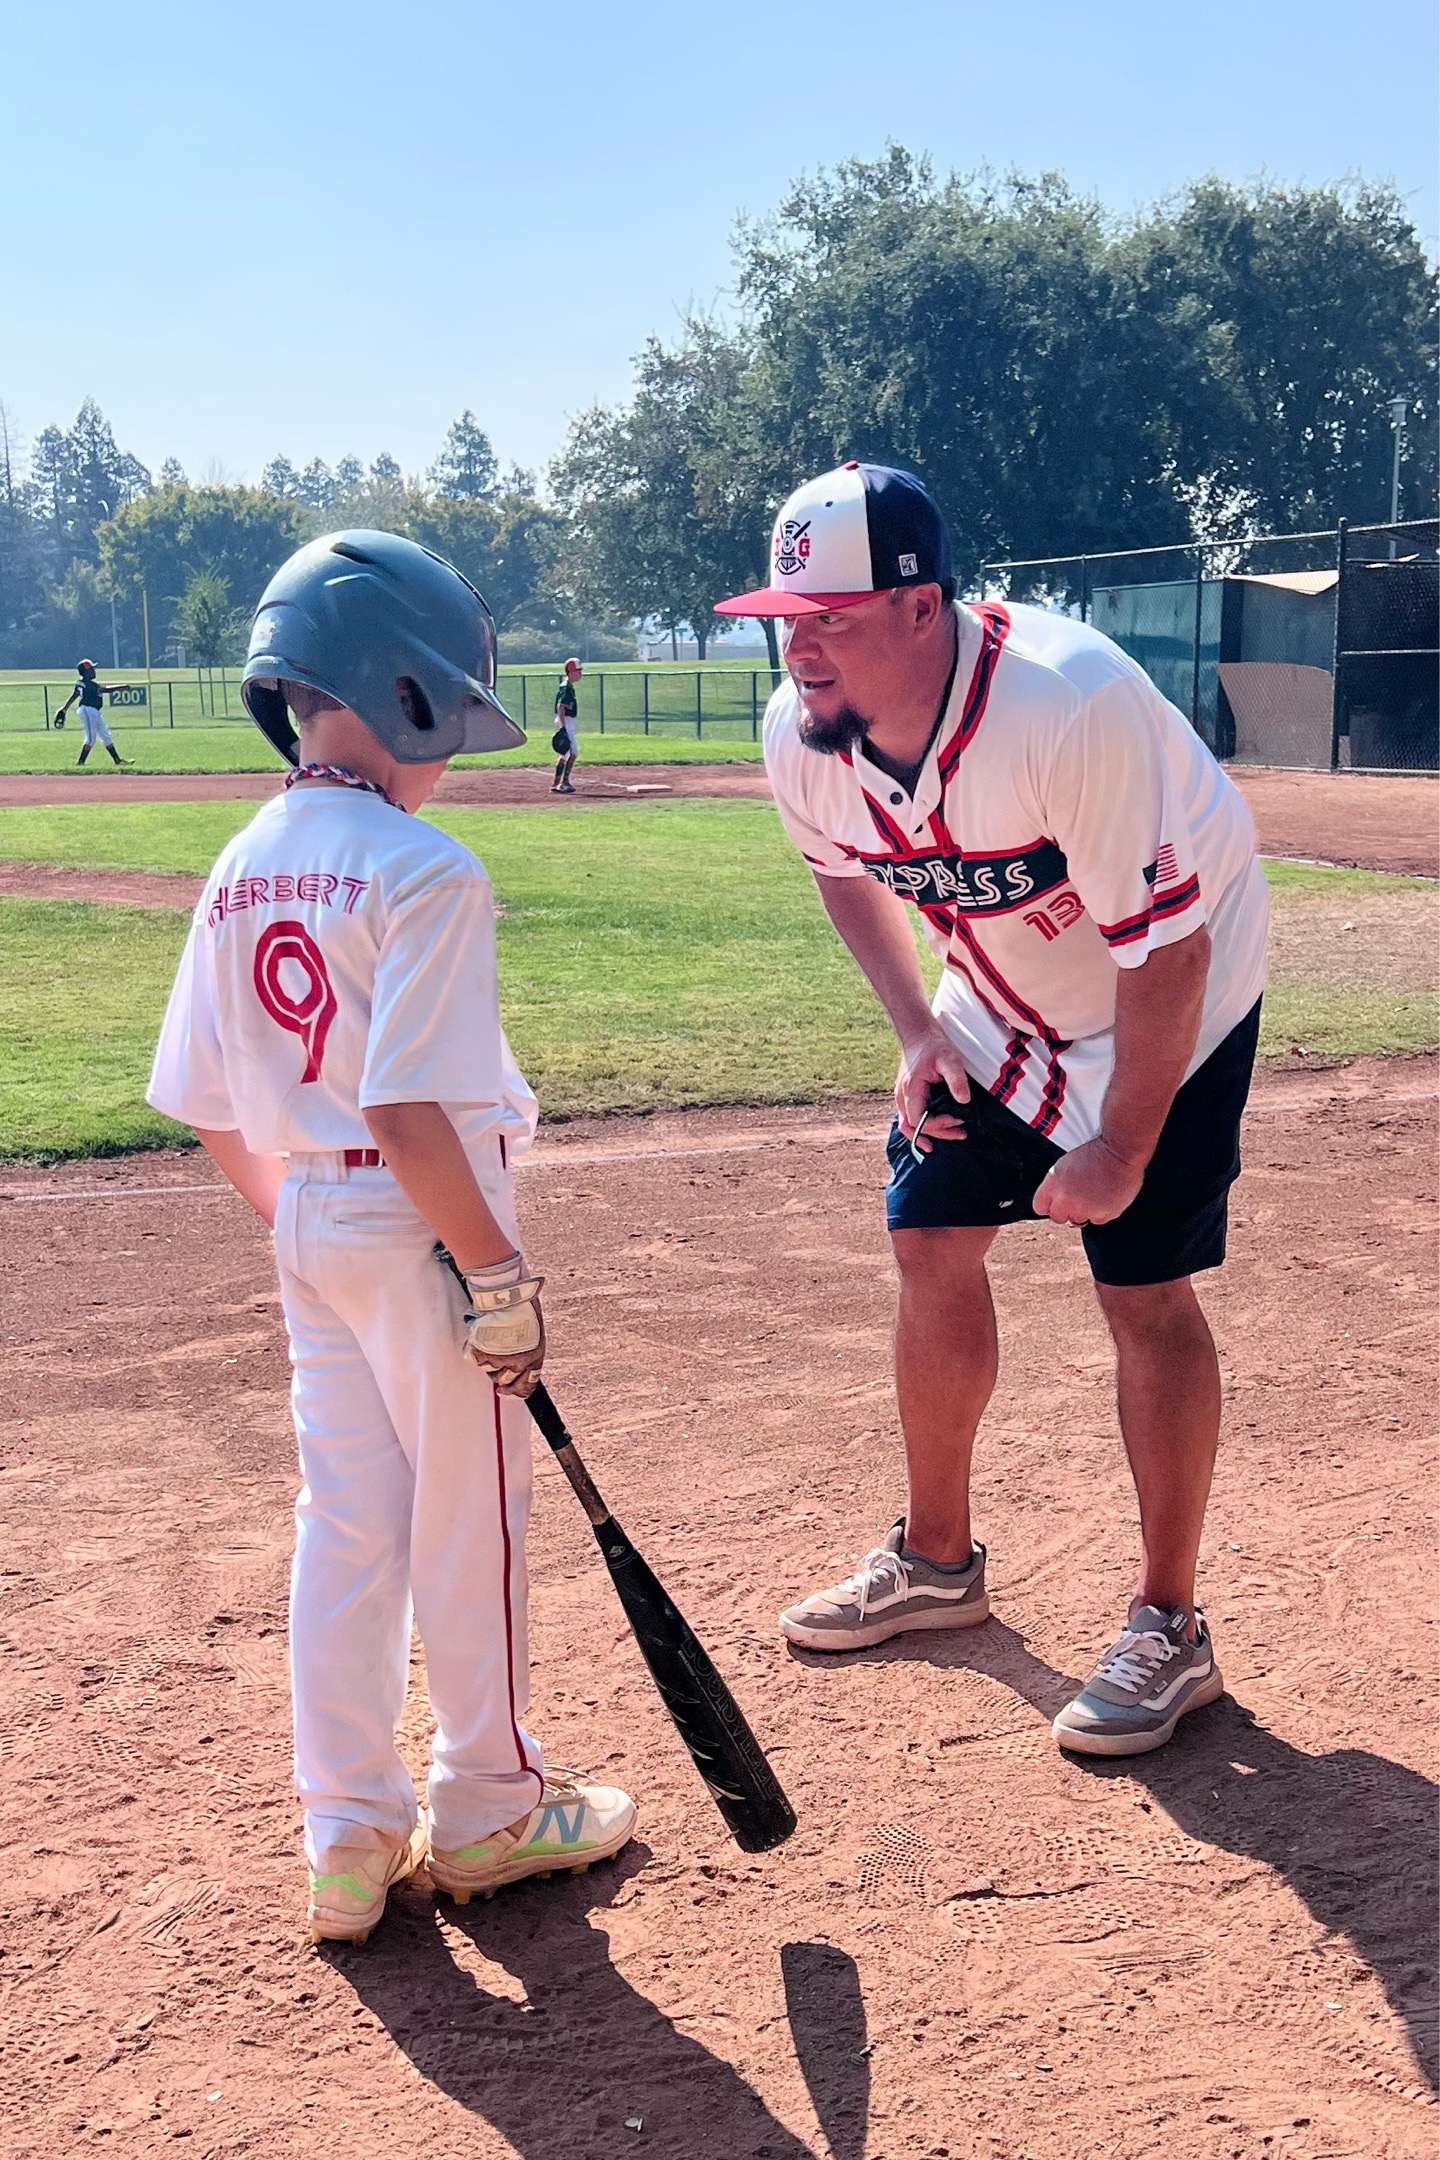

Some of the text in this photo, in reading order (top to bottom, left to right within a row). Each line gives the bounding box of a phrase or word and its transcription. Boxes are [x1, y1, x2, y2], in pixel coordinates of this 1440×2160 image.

[112, 689, 144, 705] 200'
[207, 873, 371, 928] HERBERT
[1022, 890, 1087, 942] 13
[253, 920, 338, 1085] 9
